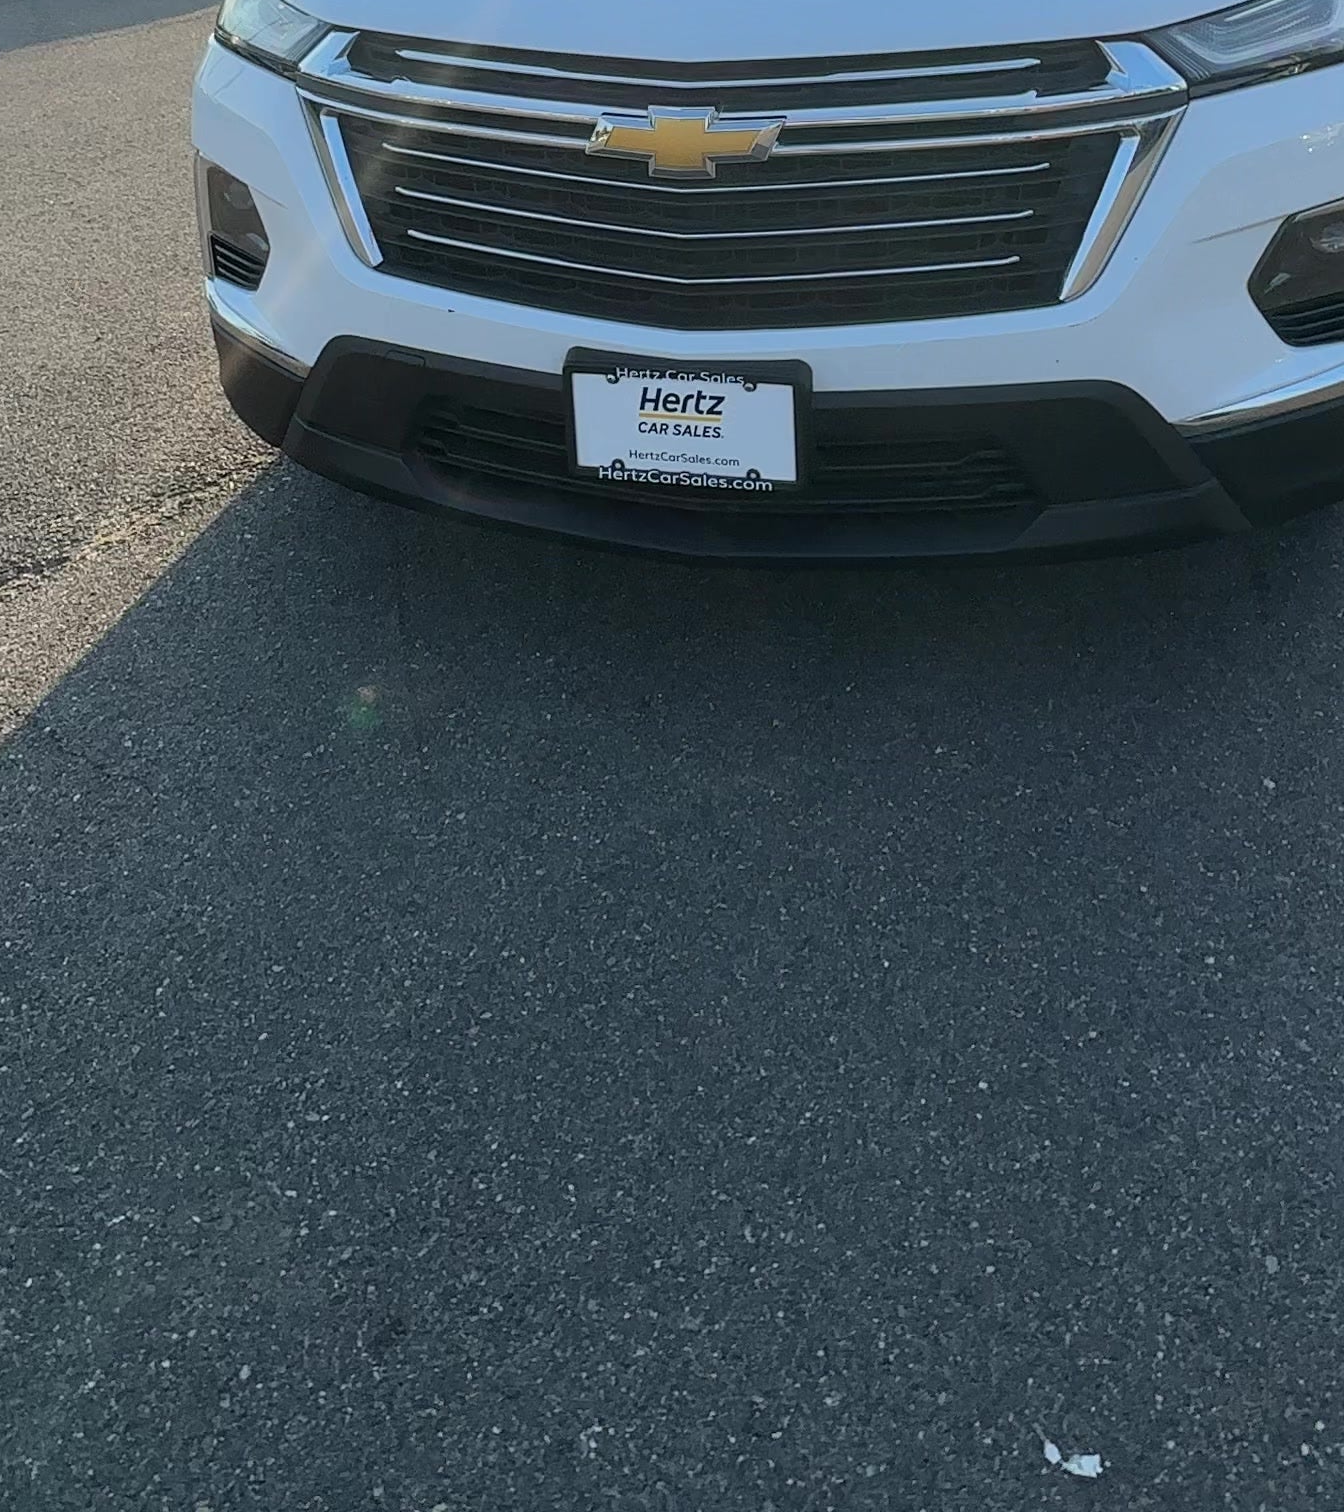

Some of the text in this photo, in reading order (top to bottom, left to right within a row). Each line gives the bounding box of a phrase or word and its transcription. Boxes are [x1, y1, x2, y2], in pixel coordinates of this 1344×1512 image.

[616, 367, 745, 385] Hertz Car Sales
[639, 387, 725, 415] Hertz
[638, 421, 669, 435] CAR
[629, 449, 740, 466] HertzCarSales.com
[598, 467, 773, 491] HertzCarSales.com
